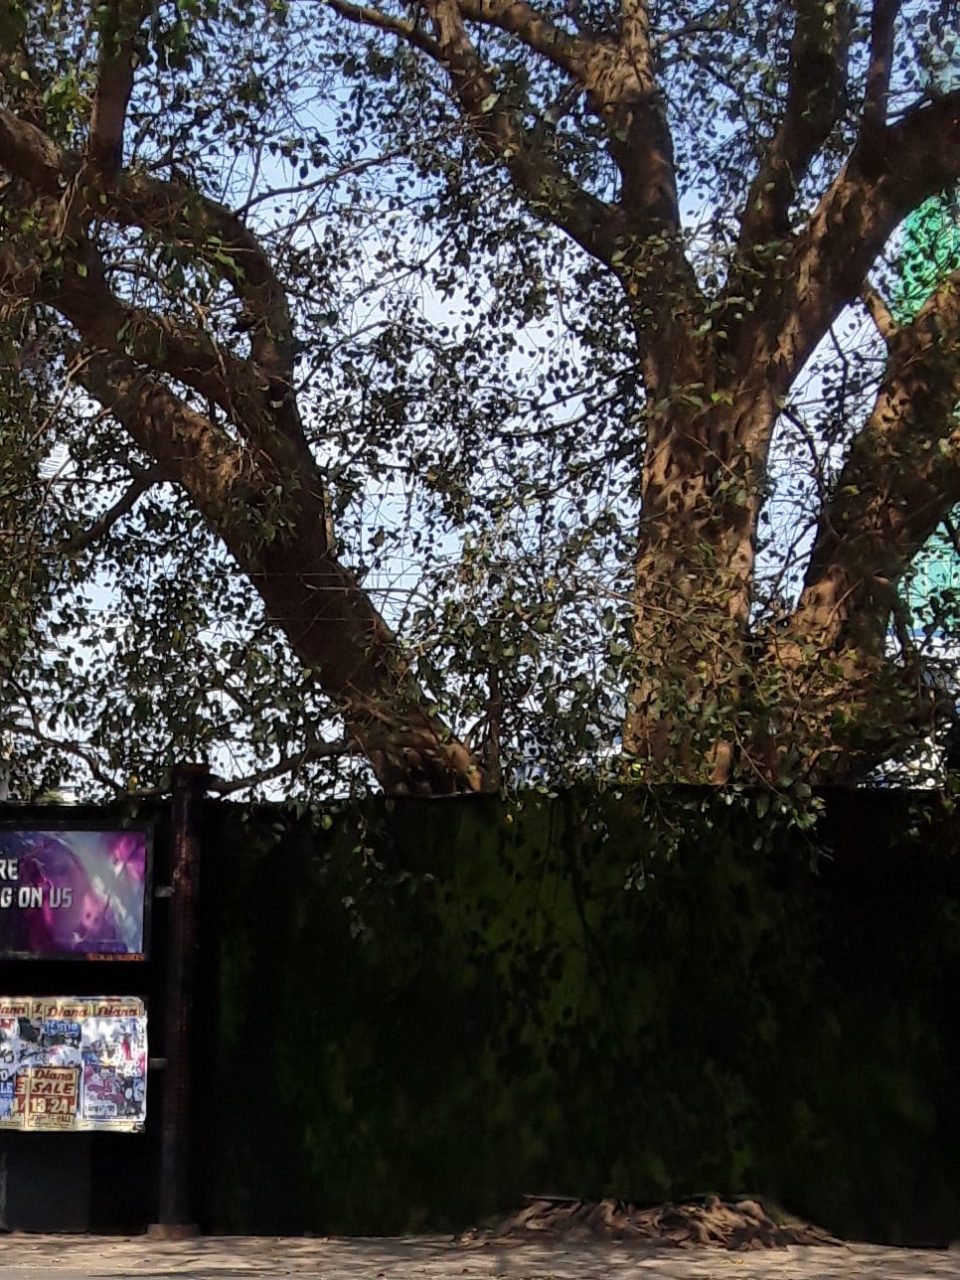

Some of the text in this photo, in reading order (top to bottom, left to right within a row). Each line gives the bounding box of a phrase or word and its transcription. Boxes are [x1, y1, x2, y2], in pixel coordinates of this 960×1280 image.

[18, 886, 43, 909] ON
[49, 887, 73, 908] US
[34, 1069, 74, 1081] Diana
[32, 1082, 74, 1095] SALE
